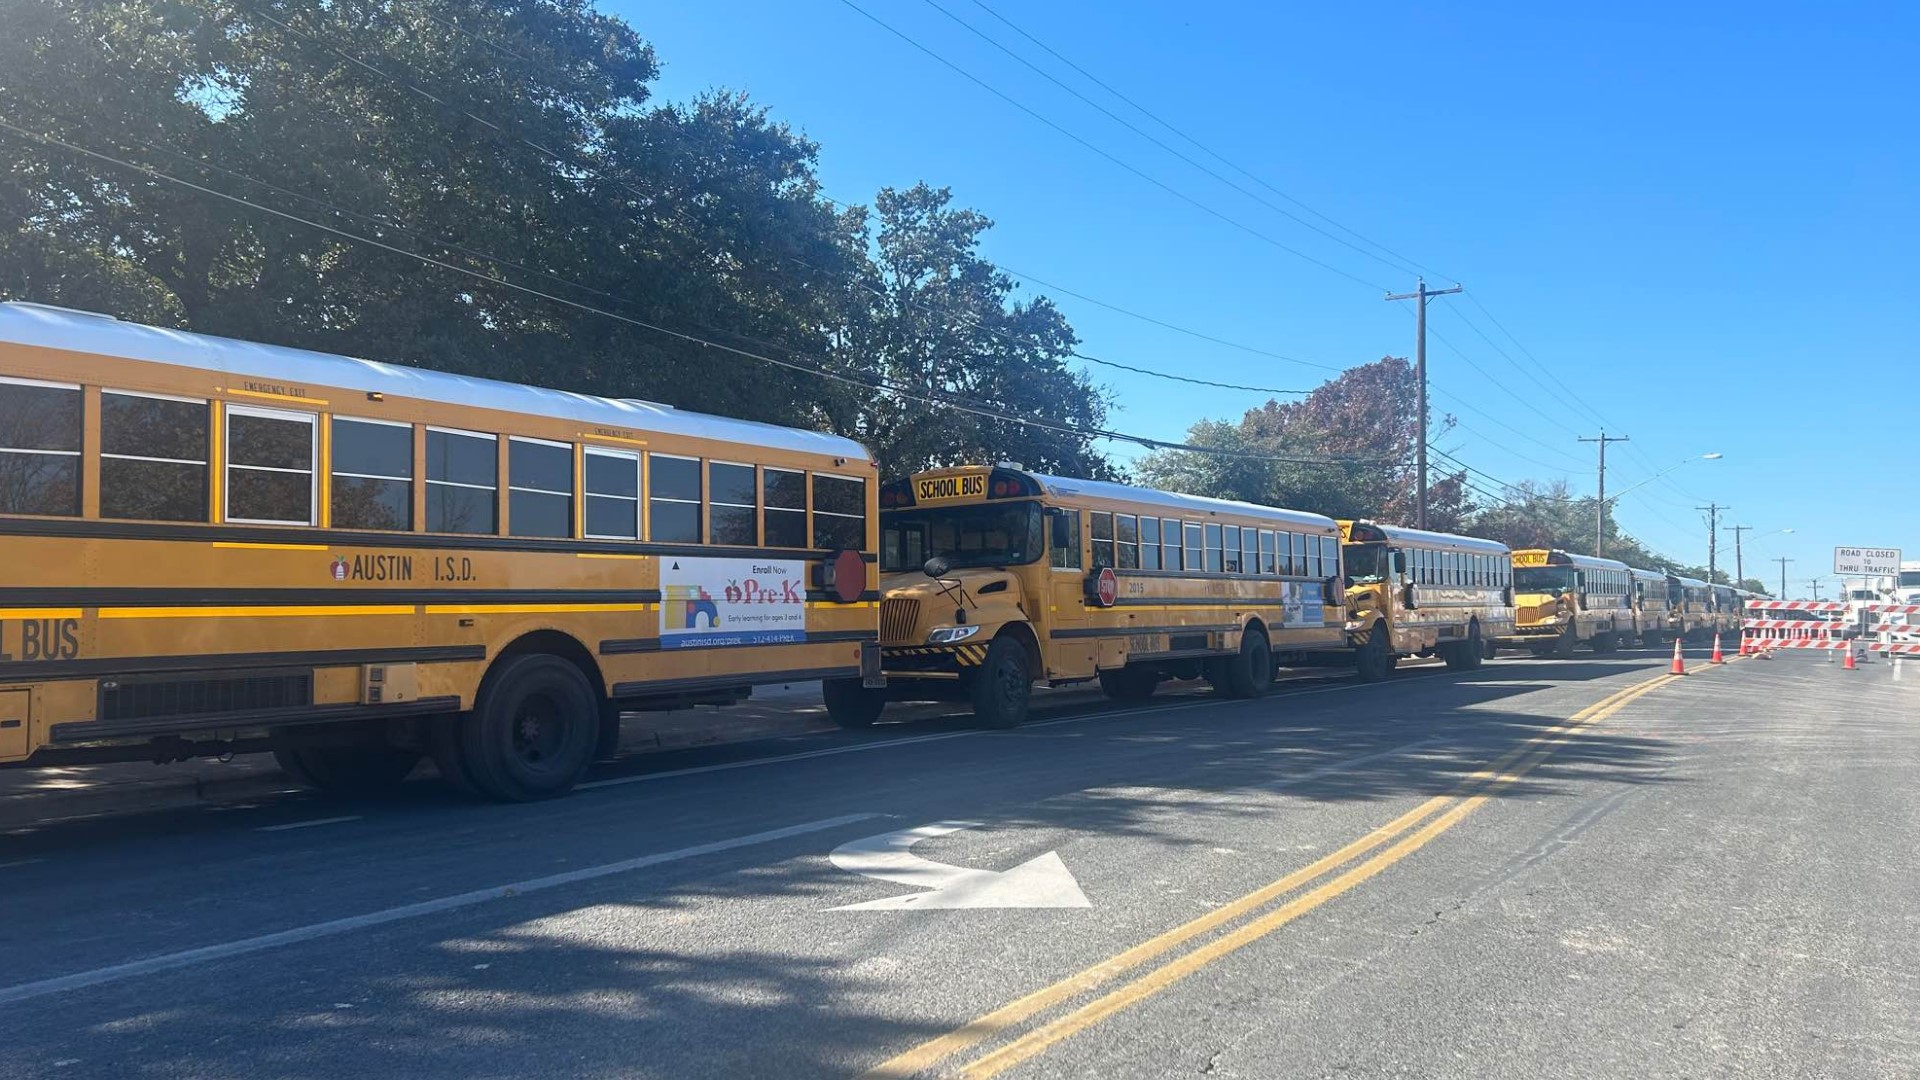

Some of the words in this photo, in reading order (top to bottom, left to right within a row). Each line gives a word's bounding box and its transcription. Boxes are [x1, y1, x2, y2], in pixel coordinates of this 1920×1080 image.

[244, 381, 285, 395] EMERGENCY
[290, 387, 305, 398] EXIT
[920, 479, 960, 499] SCHOOL
[962, 476, 983, 495] BUS
[1840, 549, 1861, 557] ROAD
[1866, 550, 1895, 559] CLOSED
[352, 554, 412, 581] AUSTIN
[435, 556, 476, 581] I.S.D.
[752, 565, 772, 574] Enroll
[773, 566, 787, 575] Now
[1840, 564, 1859, 572] THRU
[1864, 565, 1895, 574] TRAFFIC
[743, 579, 801, 604] Pre-K
[1129, 582, 1144, 593] 2015
[22, 618, 79, 661] BUS
